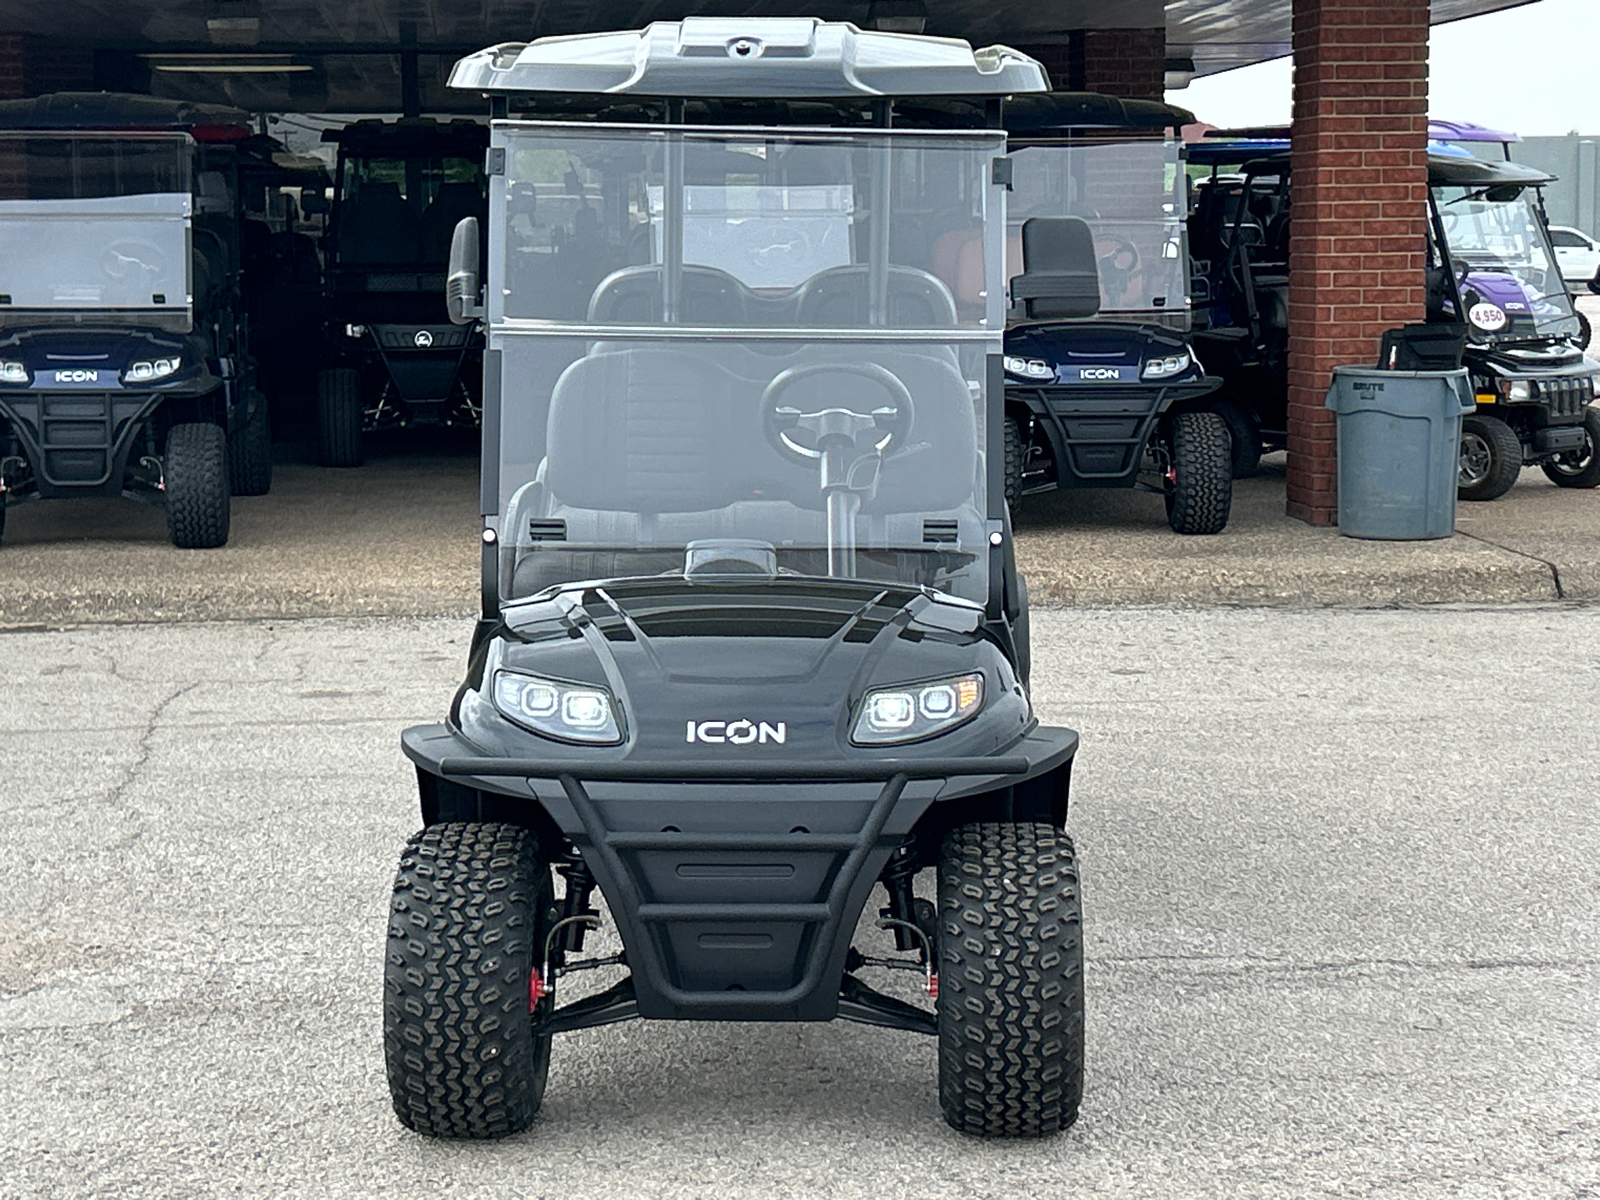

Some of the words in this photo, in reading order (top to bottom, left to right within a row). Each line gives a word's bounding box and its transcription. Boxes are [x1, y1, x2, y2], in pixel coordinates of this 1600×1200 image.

[55, 370, 98, 382] ICON
[1080, 368, 1119, 379] ICON
[1353, 382, 1385, 391] BRUTE
[686, 718, 786, 745] ICON
